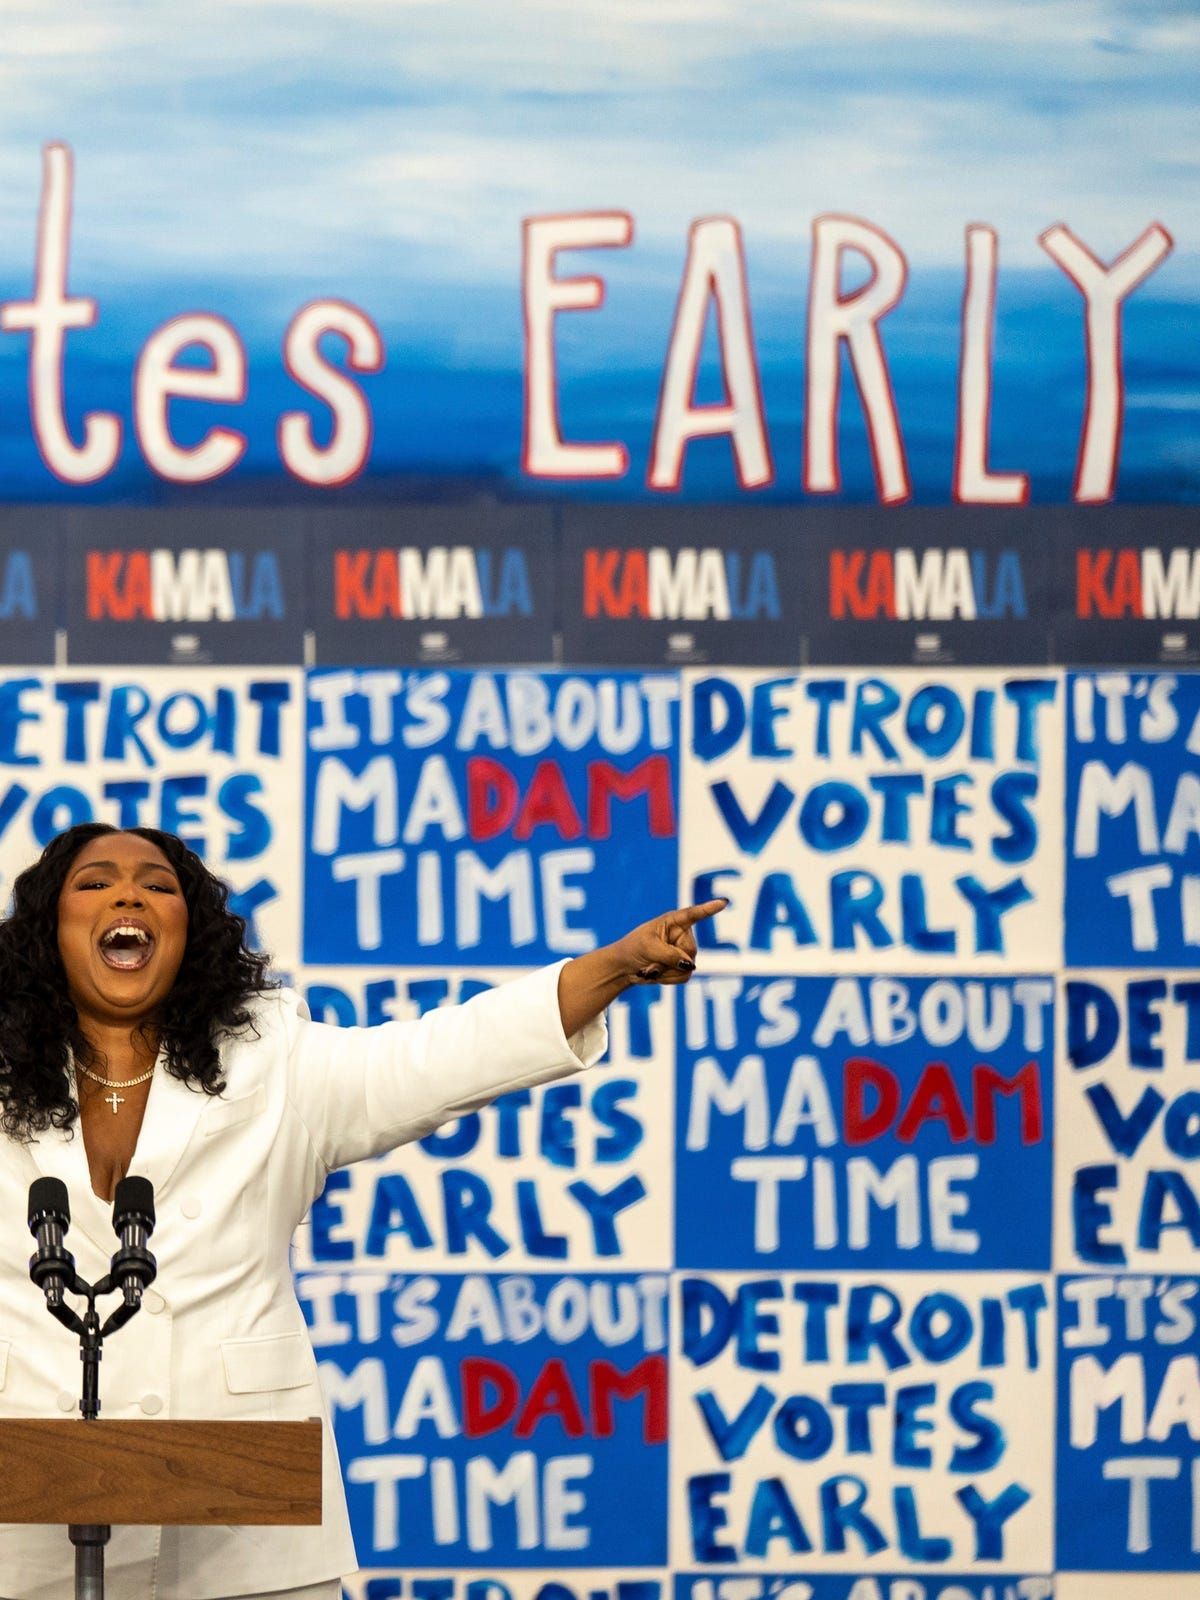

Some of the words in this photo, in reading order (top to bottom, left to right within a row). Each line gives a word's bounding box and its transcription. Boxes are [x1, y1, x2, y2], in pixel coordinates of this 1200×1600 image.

[520, 210, 1175, 505] EARLY
[86, 548, 285, 621] KAMALA
[333, 547, 533, 620] KAMALA
[584, 547, 781, 620] KAMALA
[829, 547, 1027, 620] KAMALA
[455, 671, 680, 757] ABOUT
[692, 676, 1057, 765] DETROIT
[1073, 672, 1179, 744] IT'S
[311, 753, 677, 855] MADAM
[708, 770, 1039, 864] VOTES
[332, 846, 597, 954] TIME
[692, 867, 1035, 954] EARLY
[683, 978, 800, 1051] IT'S
[811, 978, 1054, 1053] ABOUT
[685, 1055, 1043, 1152] MADAM
[311, 1168, 648, 1262] EARLY
[730, 1154, 981, 1255] TIME
[444, 1273, 669, 1352] ABOUT
[680, 1278, 1048, 1373] DETROIT
[1062, 1278, 1200, 1349] IT'S
[317, 1354, 669, 1446] MADAM
[693, 1380, 1008, 1474] VOTES
[347, 1451, 593, 1552] TIME
[686, 1470, 1032, 1564] EARLY
